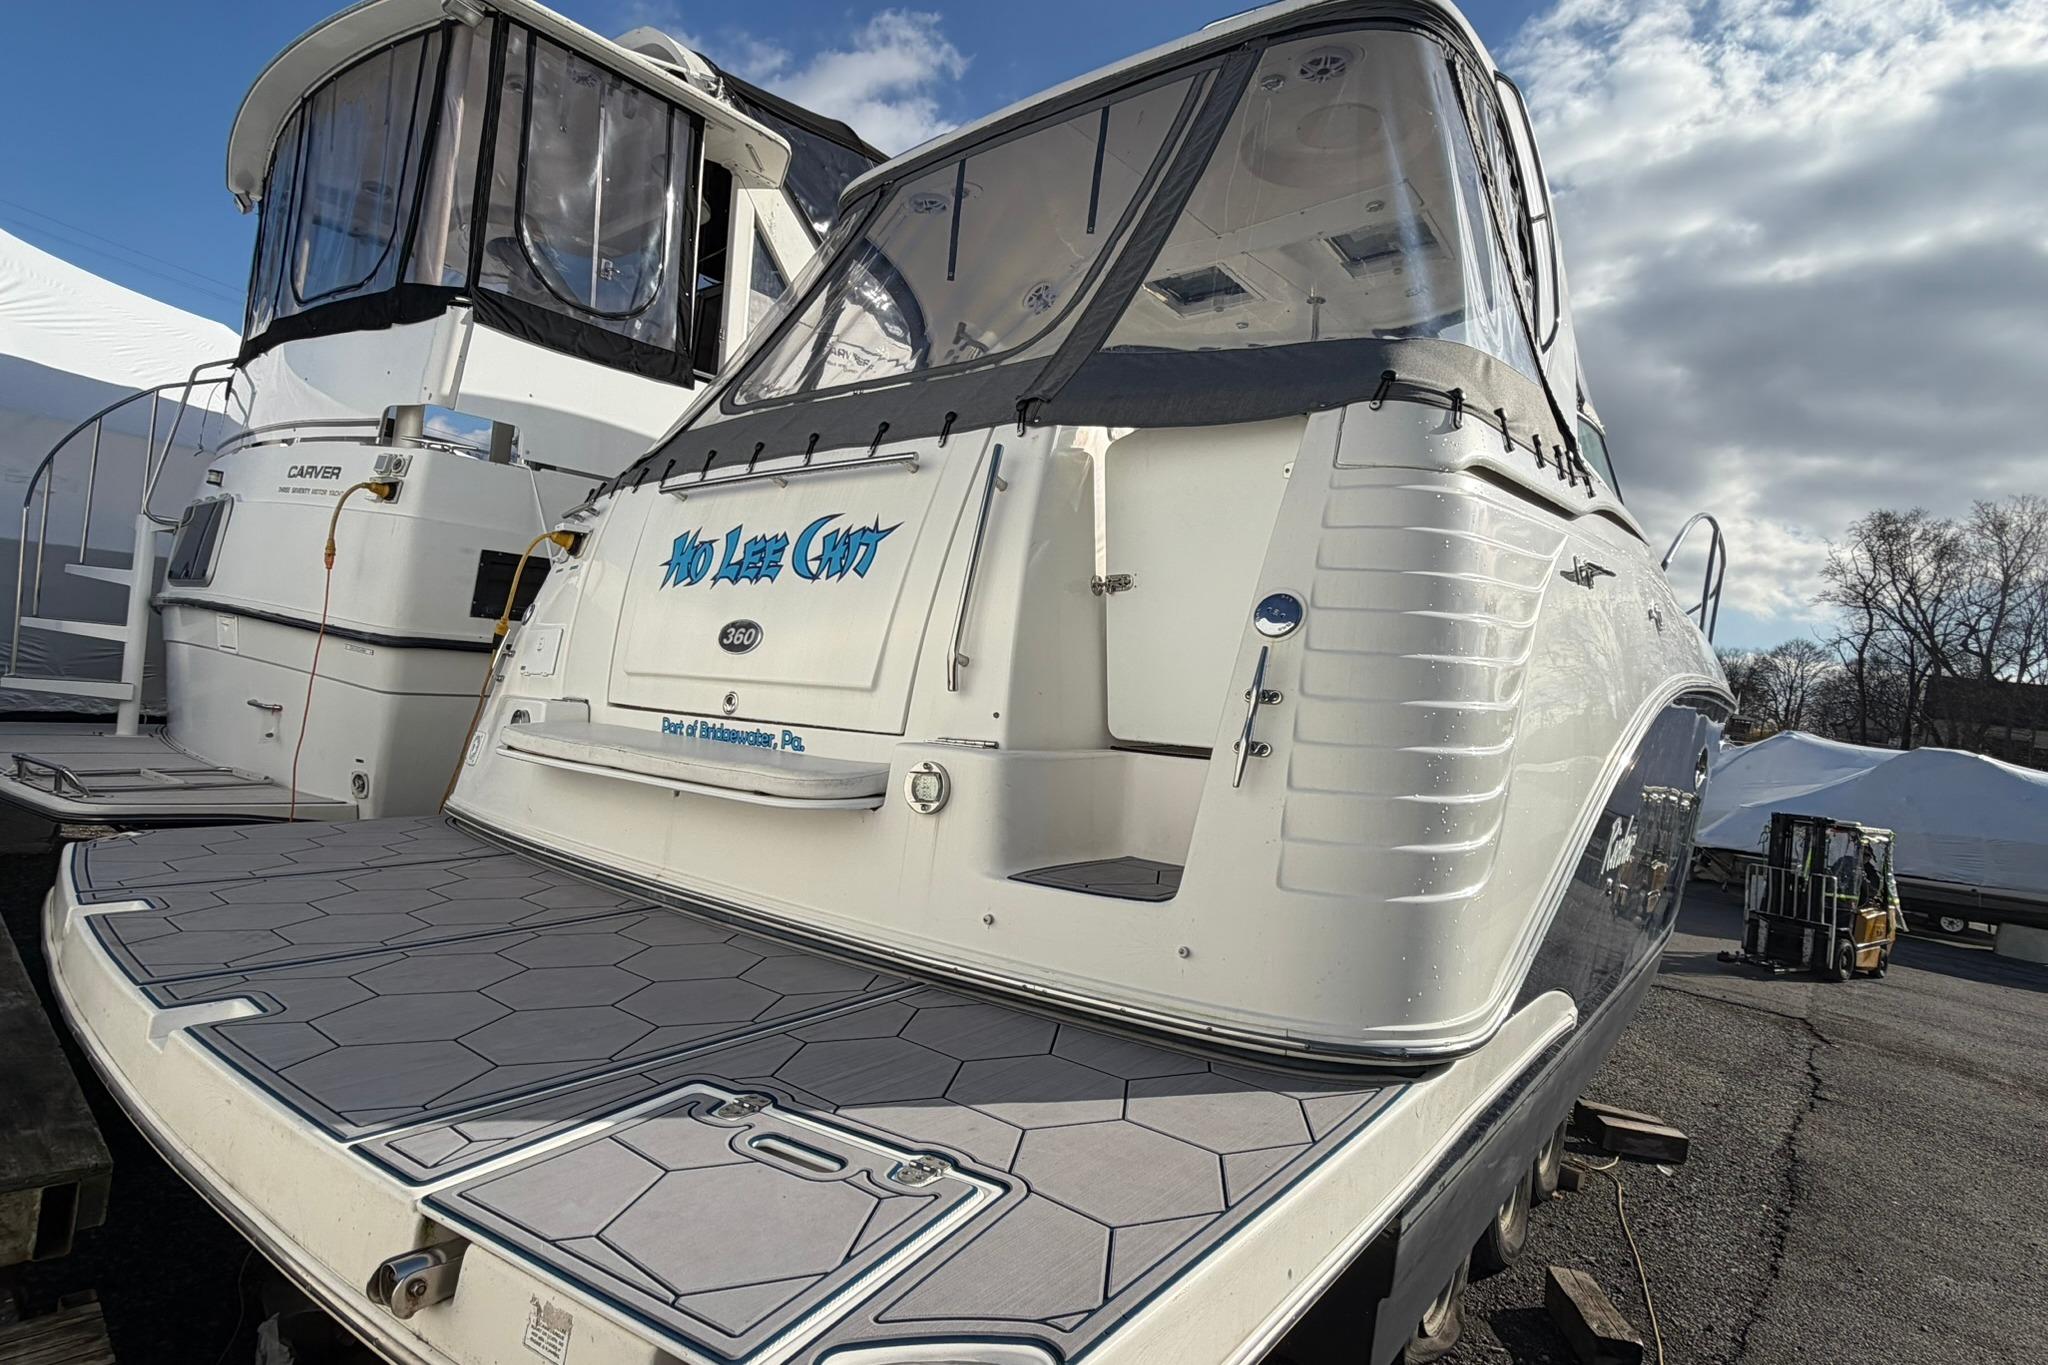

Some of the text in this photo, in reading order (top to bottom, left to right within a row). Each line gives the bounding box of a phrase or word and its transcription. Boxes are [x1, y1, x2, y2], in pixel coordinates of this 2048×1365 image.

[287, 465, 342, 480] CARVER
[659, 526, 720, 591] HO
[710, 523, 790, 590] LEE
[722, 627, 756, 645] 360
[661, 716, 806, 752] Port of Bridgewater, Pa.
